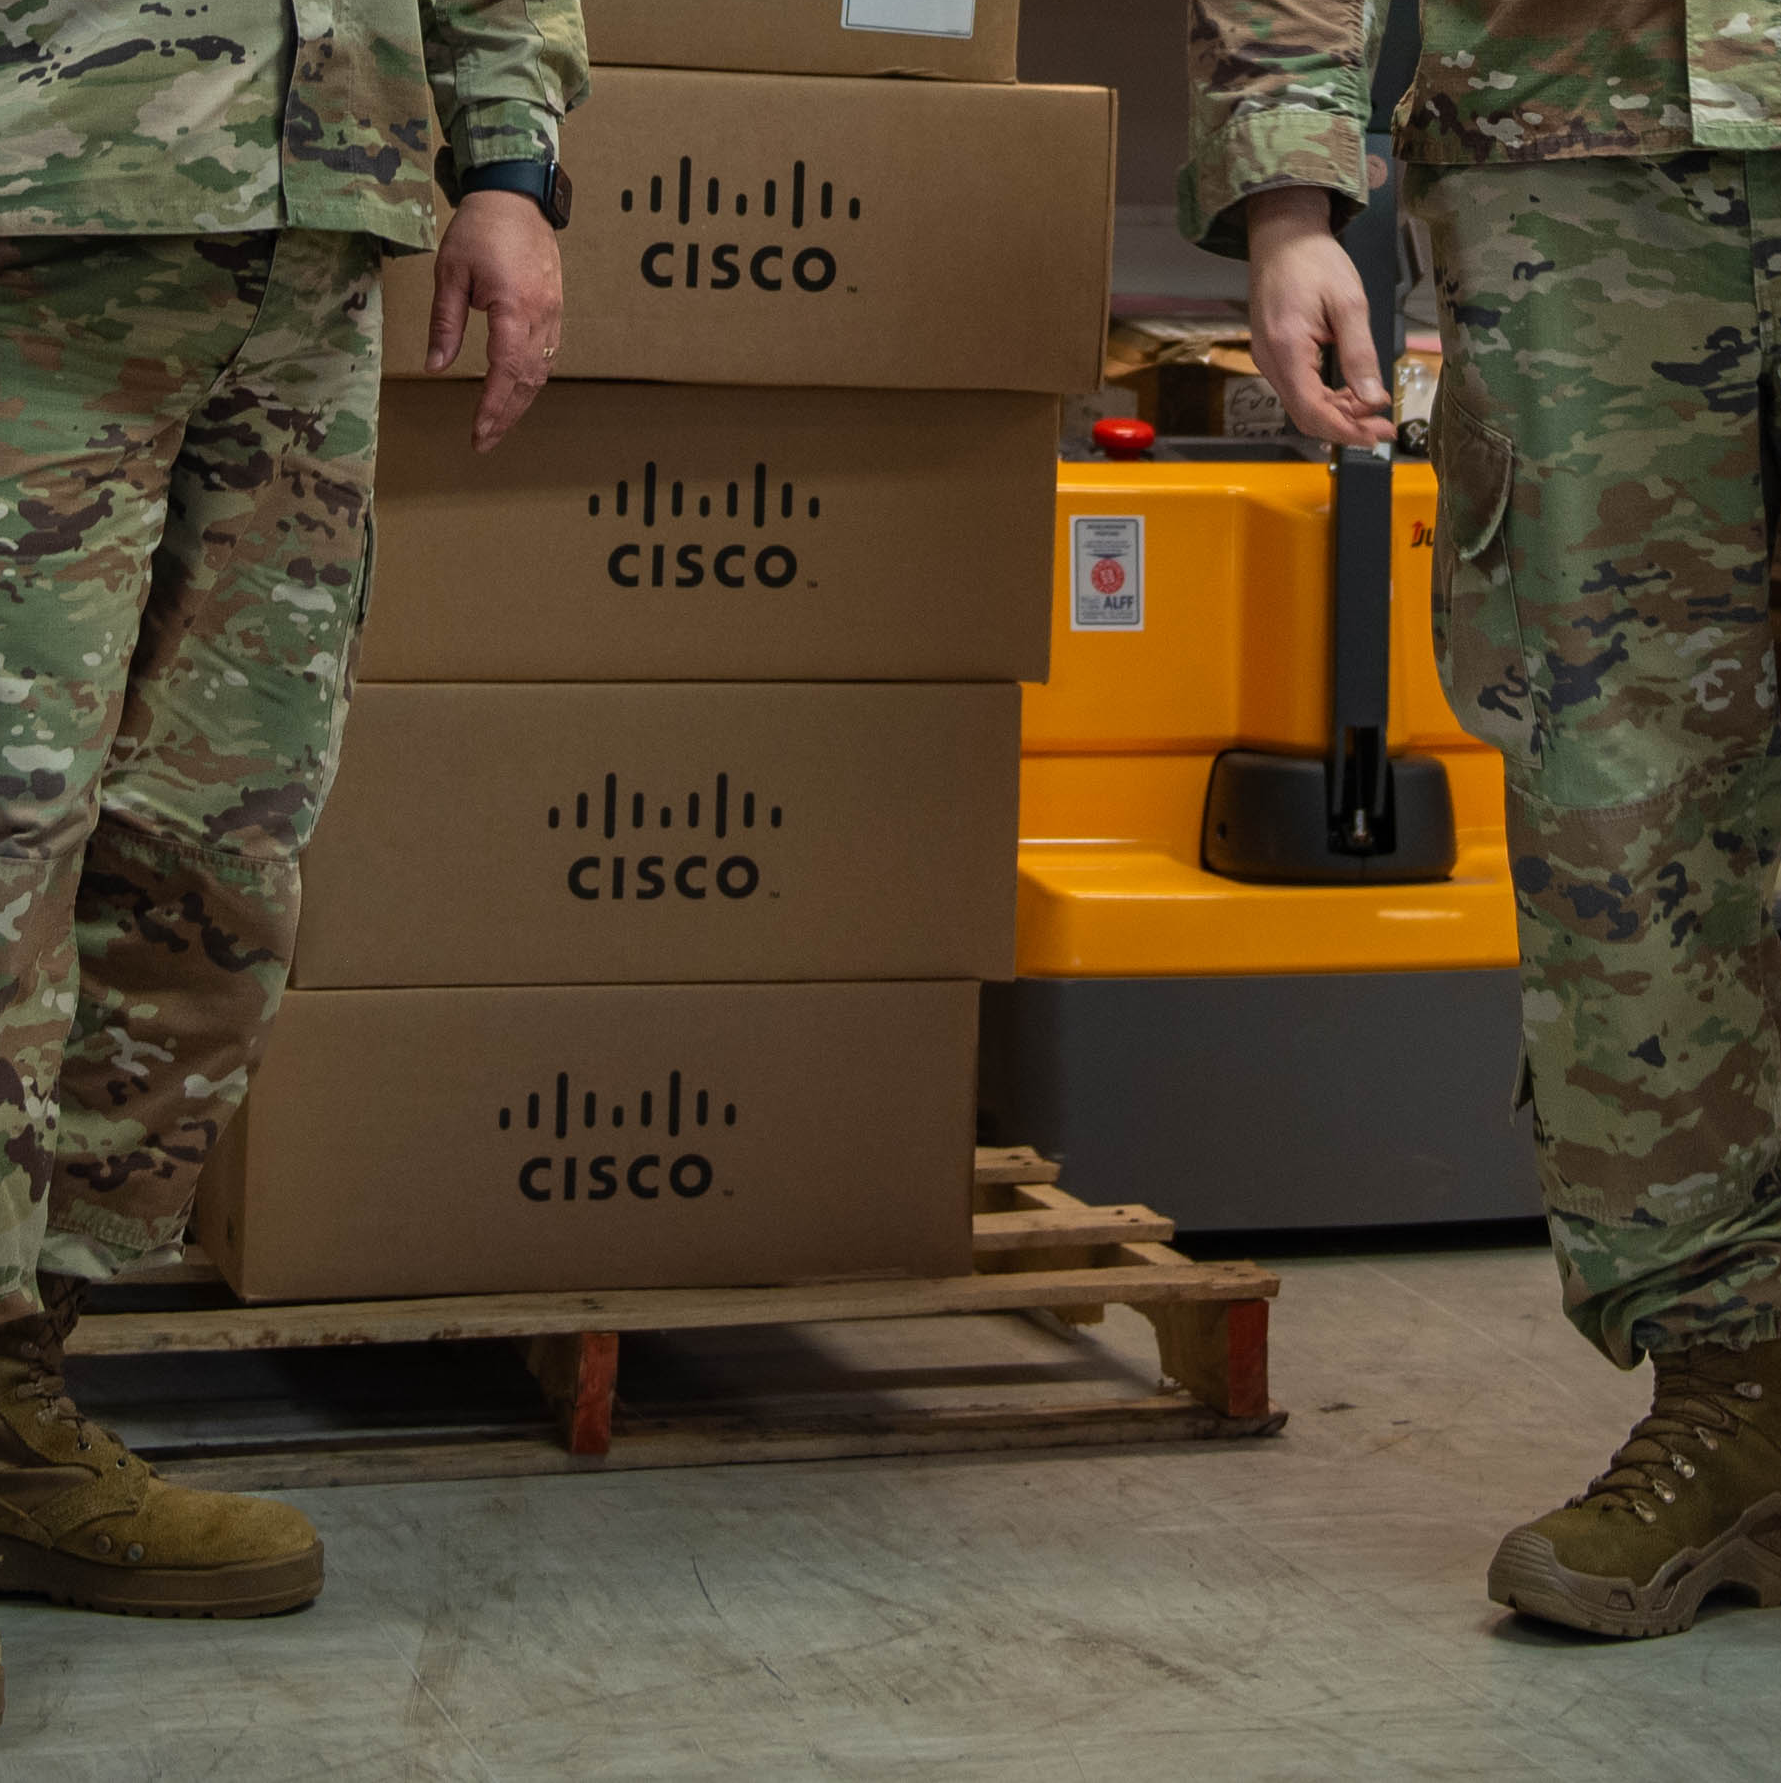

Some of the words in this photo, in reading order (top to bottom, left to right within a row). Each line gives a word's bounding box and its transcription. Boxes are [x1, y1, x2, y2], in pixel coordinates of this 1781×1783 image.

[640, 241, 837, 293] CISCO
[607, 544, 798, 589] CISCO
[567, 855, 760, 901] CISCO
[518, 1153, 713, 1202] CISCO
